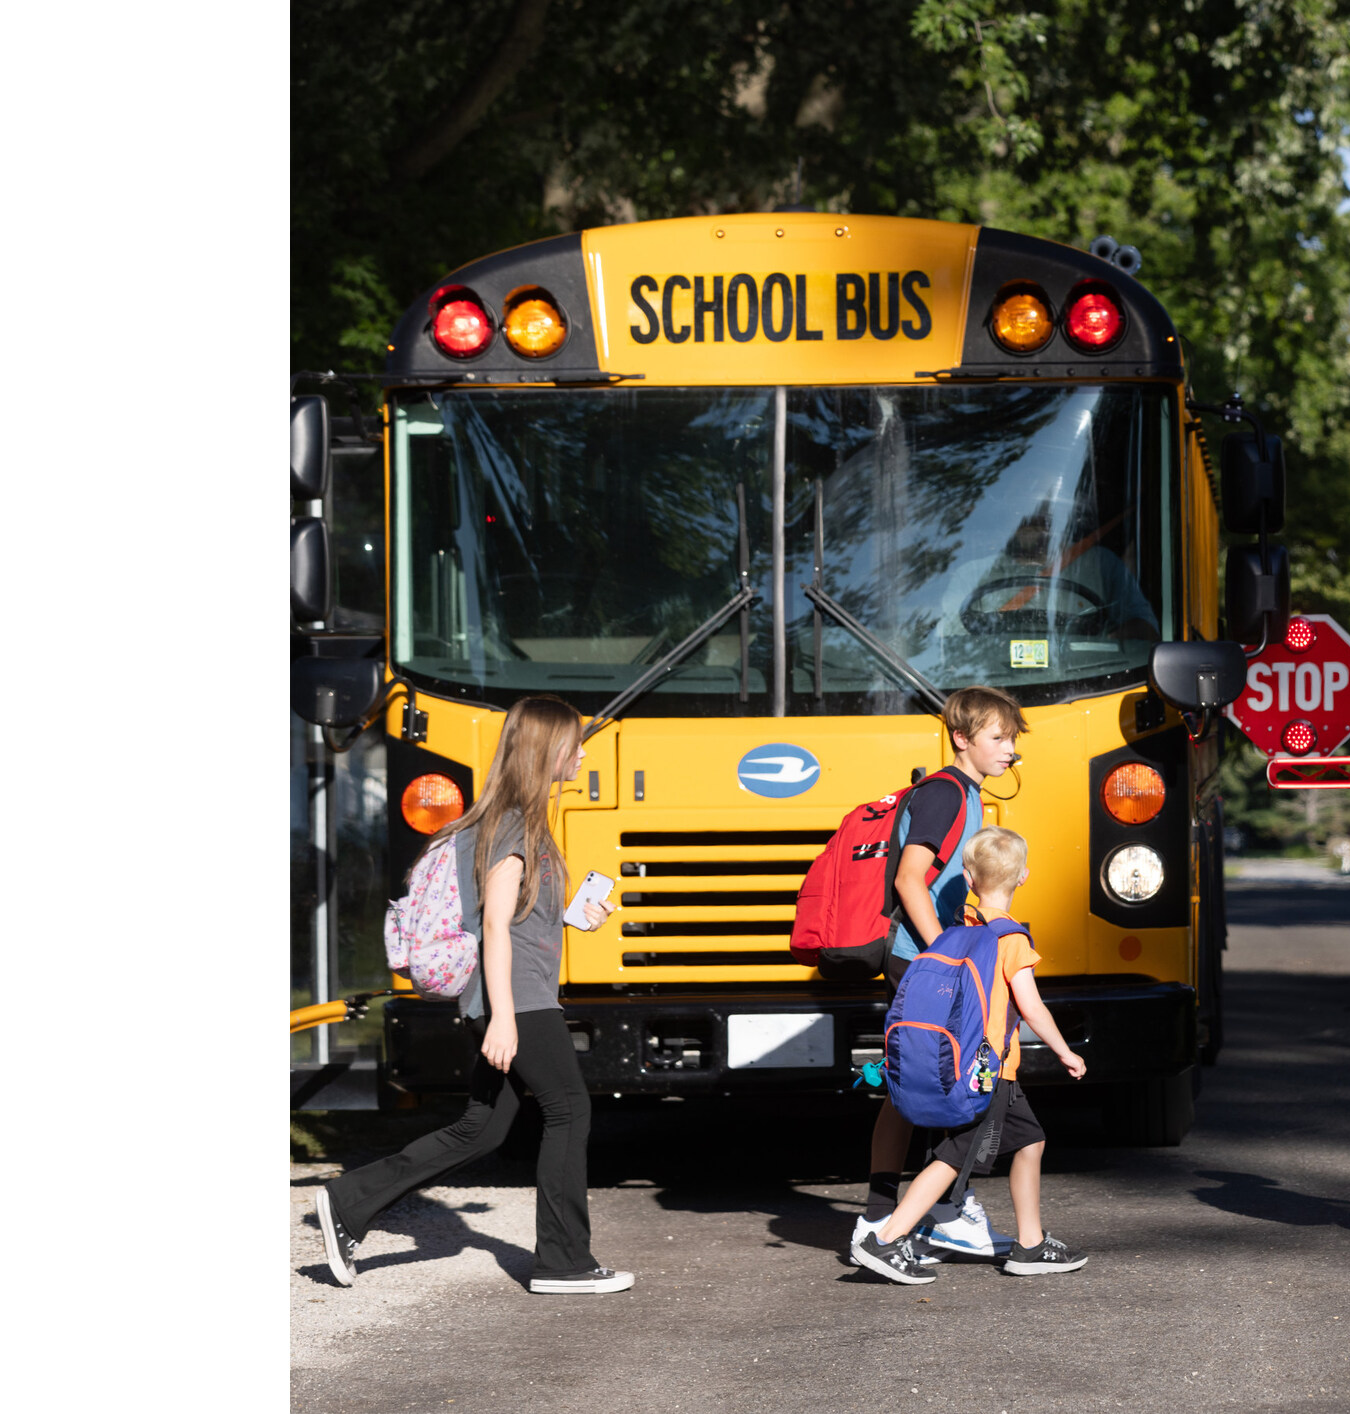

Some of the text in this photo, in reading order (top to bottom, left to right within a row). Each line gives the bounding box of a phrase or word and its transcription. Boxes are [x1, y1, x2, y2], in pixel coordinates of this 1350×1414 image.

[629, 270, 933, 345] SCHOOL BUS
[1246, 661, 1350, 712] STOP
